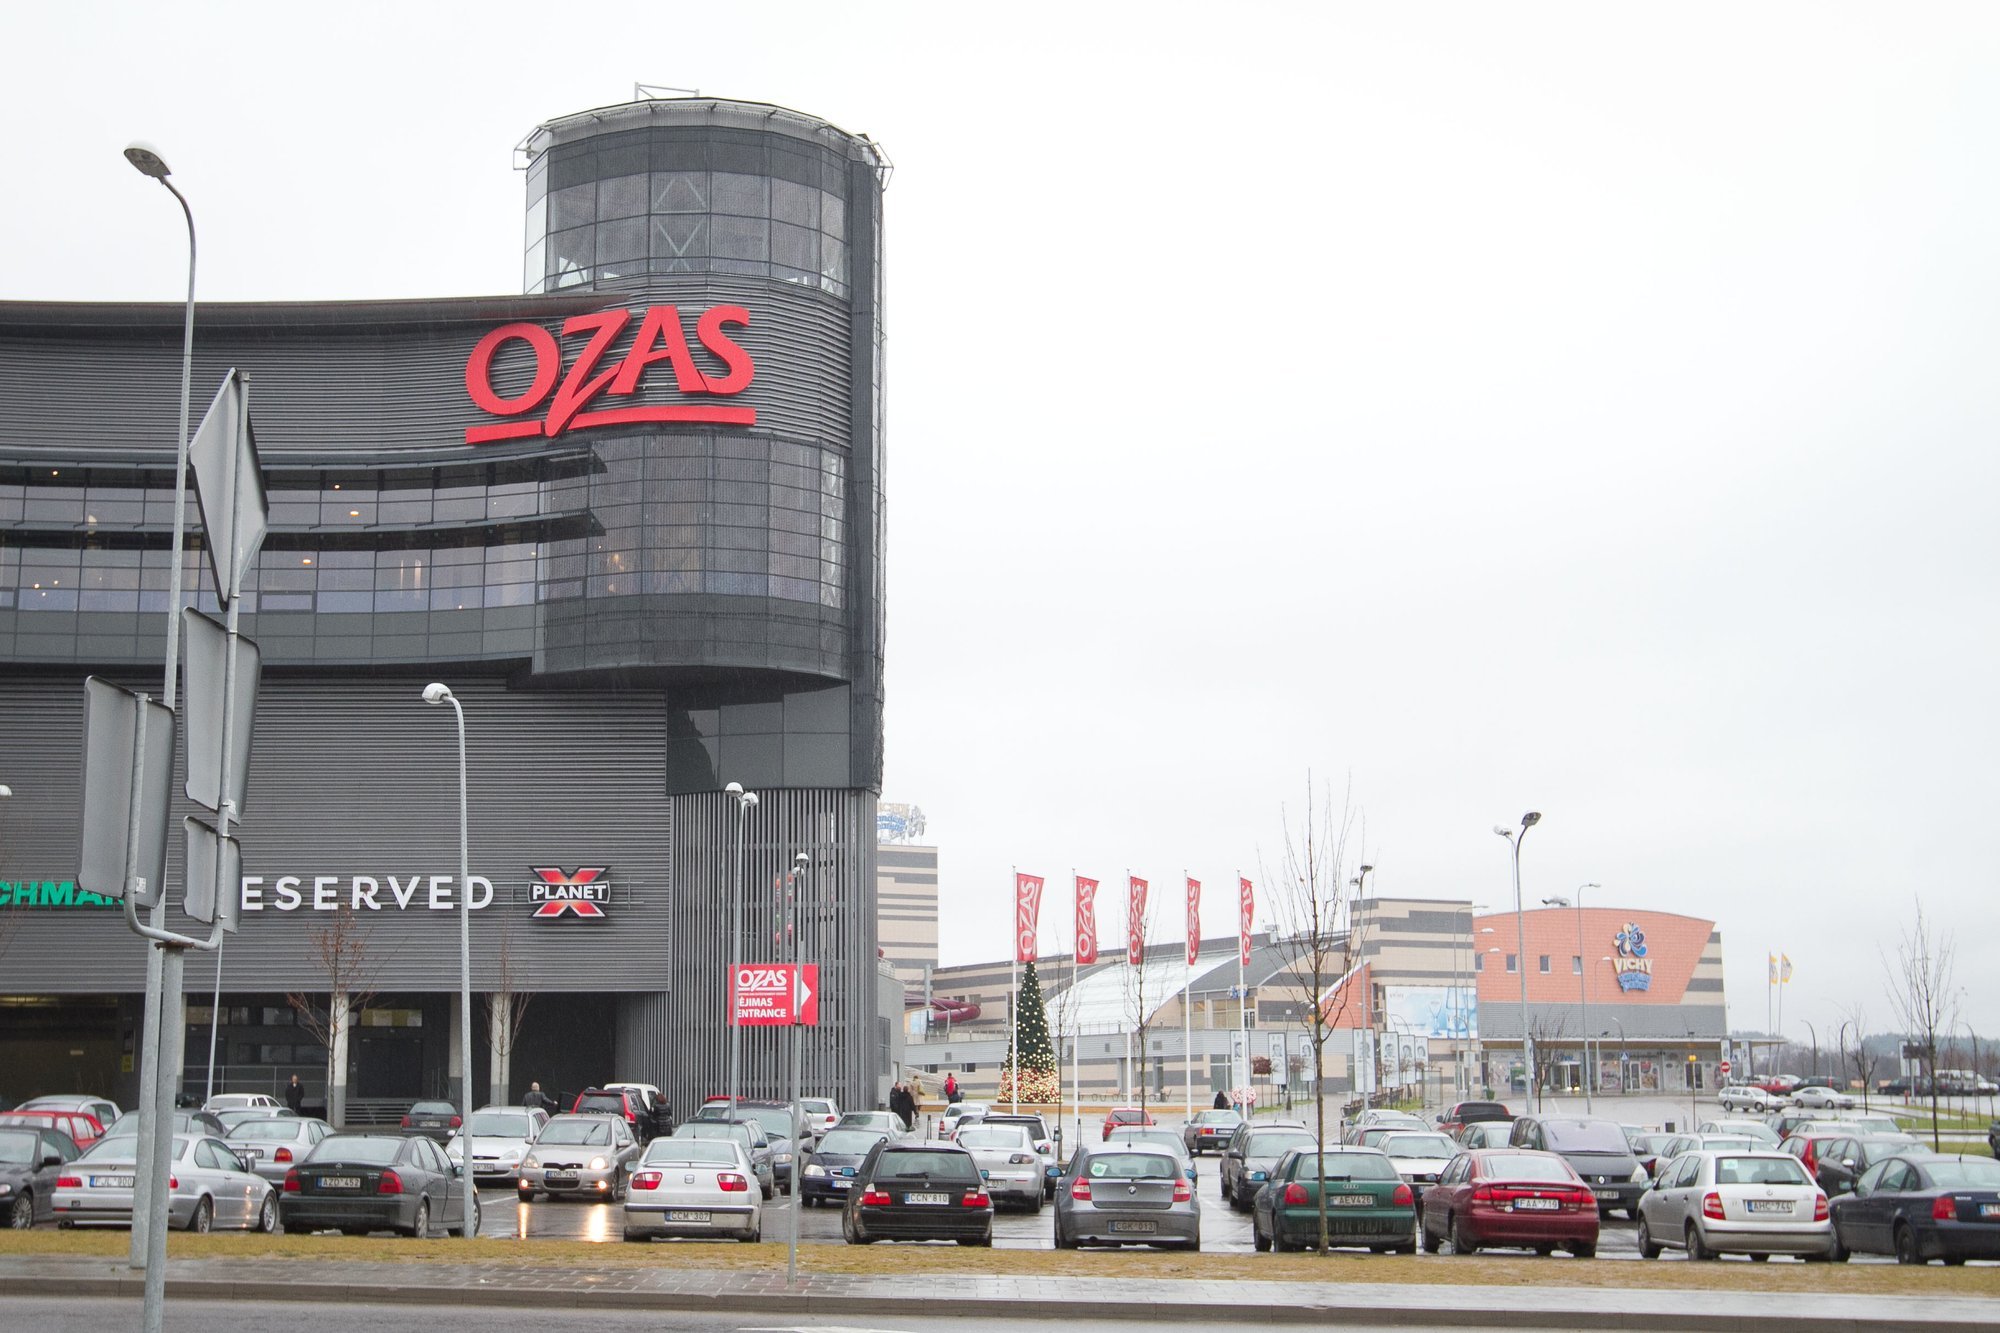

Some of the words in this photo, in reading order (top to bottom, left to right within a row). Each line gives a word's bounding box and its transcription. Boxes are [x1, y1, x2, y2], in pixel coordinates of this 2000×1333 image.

[465, 304, 755, 437] OZAS
[532, 885, 607, 900] PLANET
[1019, 881, 1037, 955] OZAS
[1077, 883, 1094, 957] OZAS
[1612, 958, 1653, 976] VICHY
[738, 969, 787, 992] OZAS
[739, 996, 773, 1007] ĖJIMAS
[737, 1008, 787, 1018] ENTRANCE
[910, 1194, 928, 1202] CCN
[933, 1194, 948, 1202] 810
